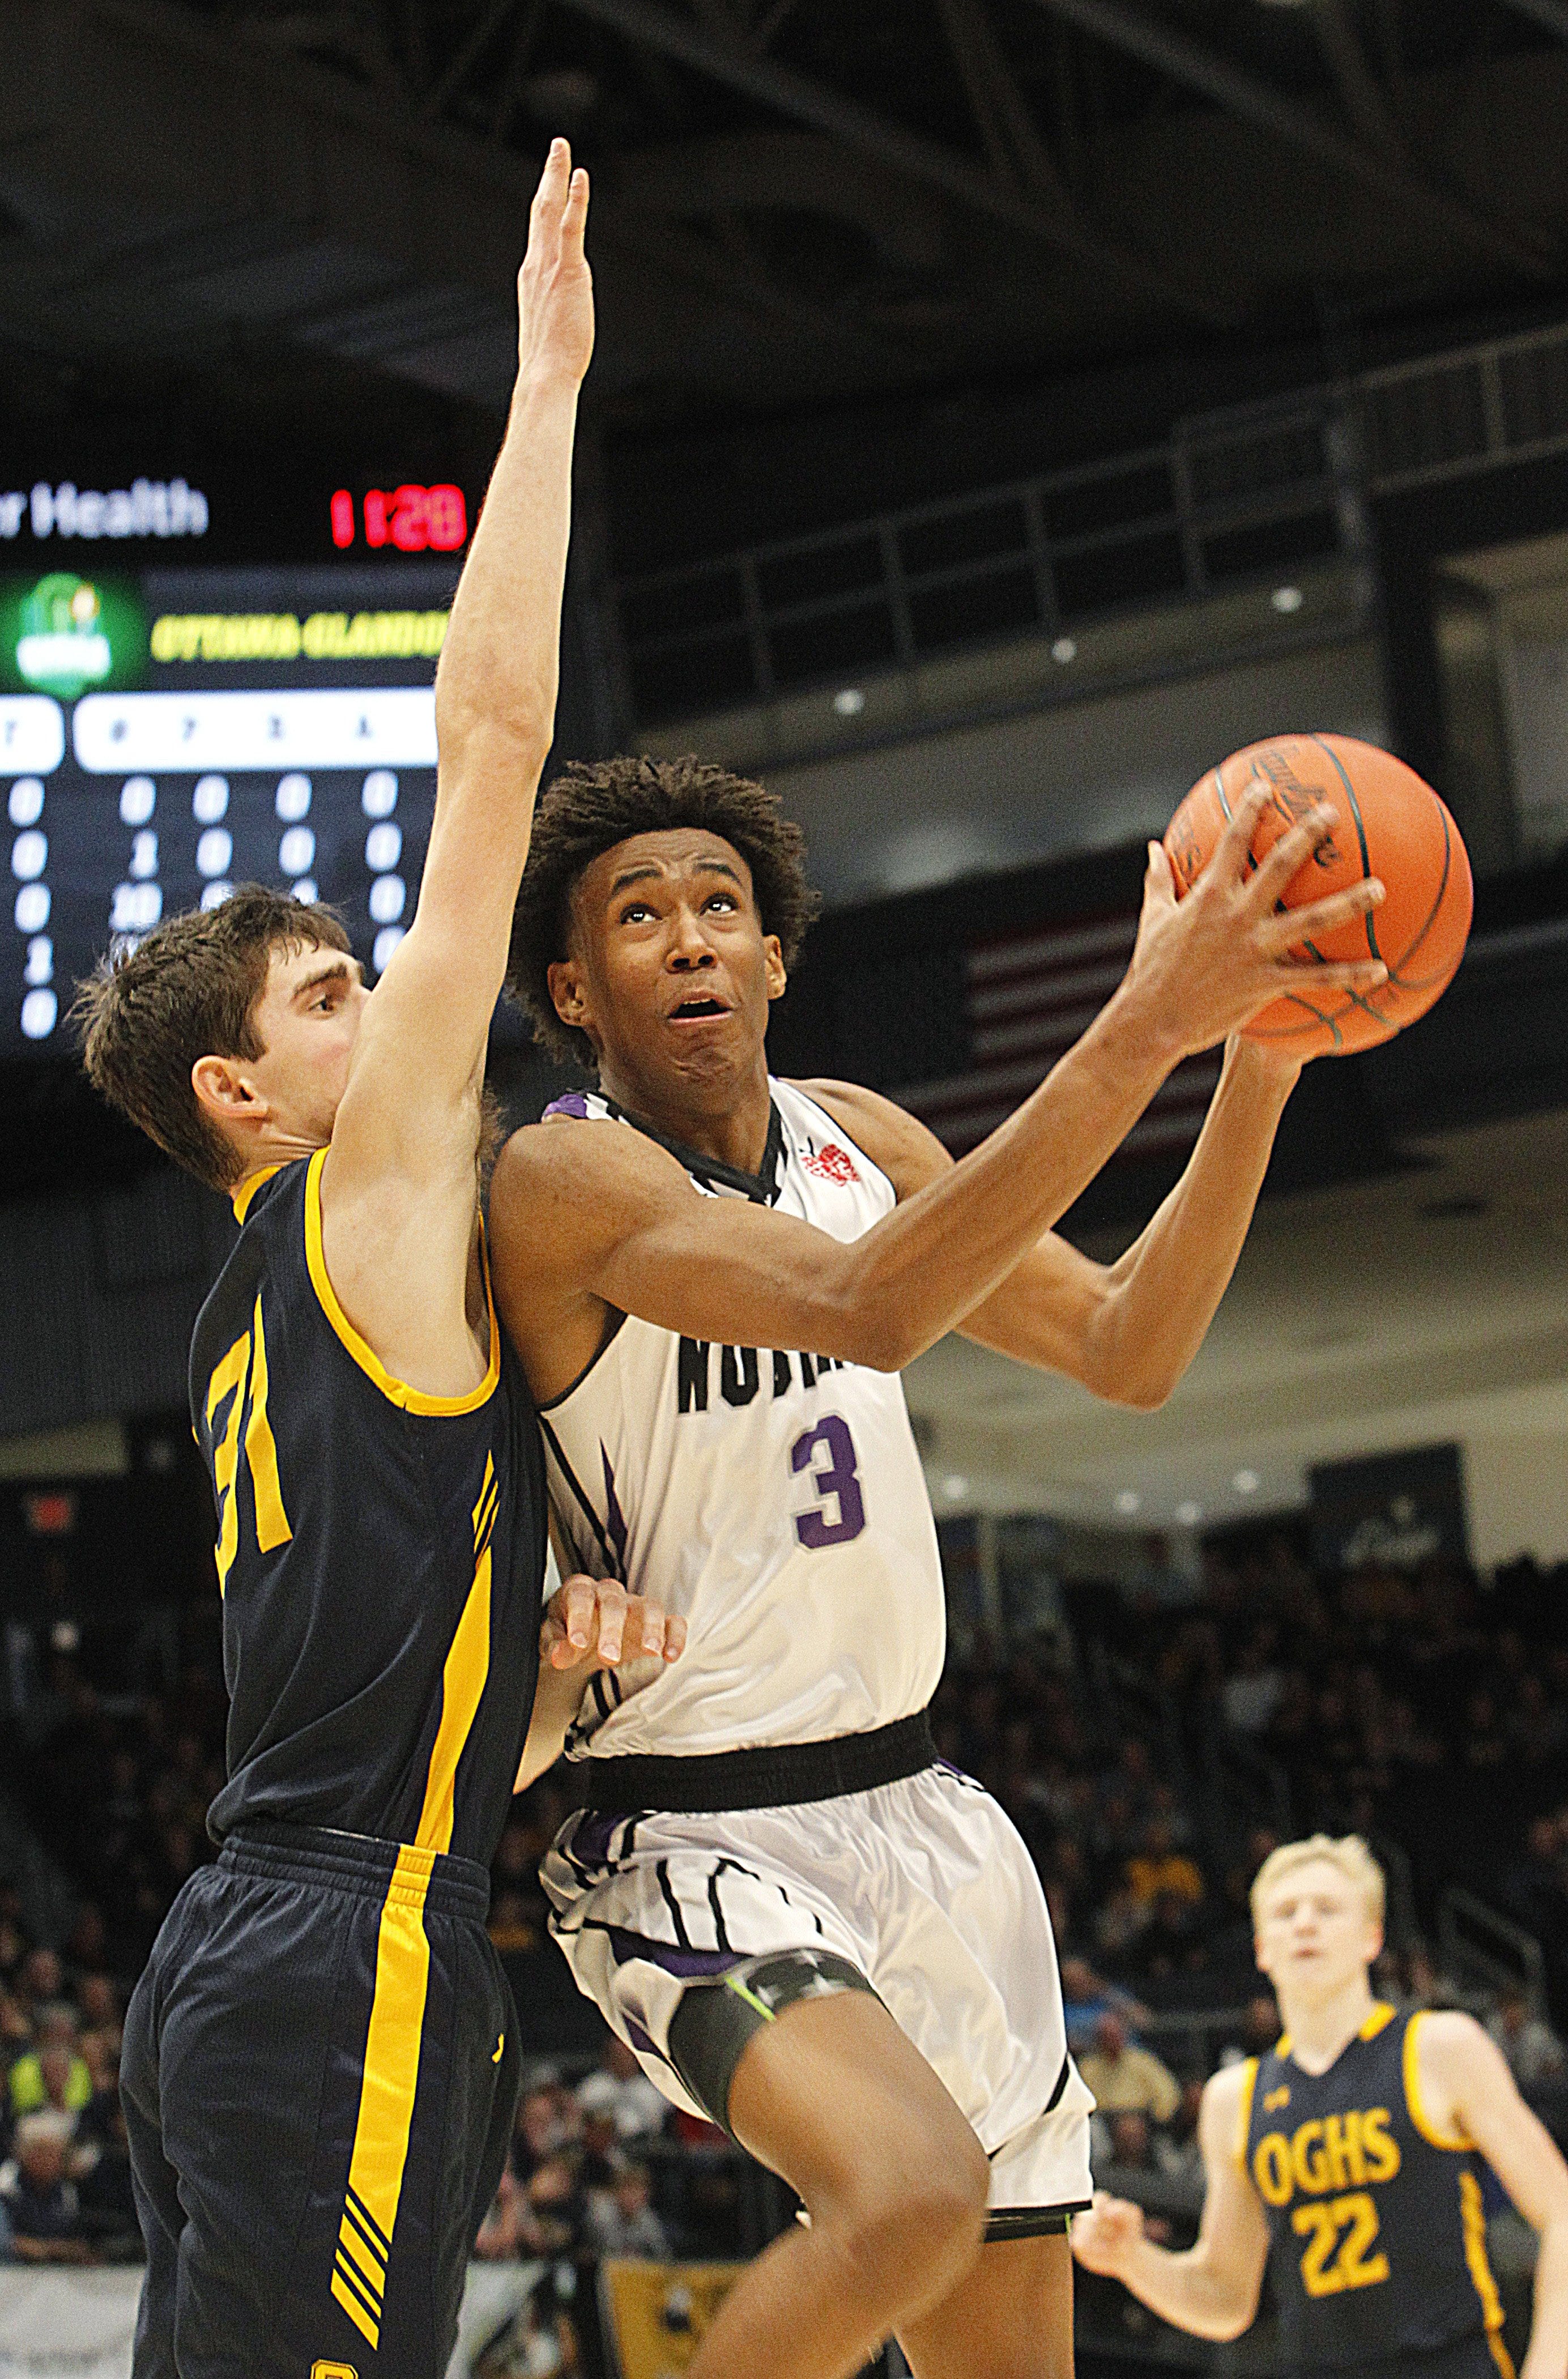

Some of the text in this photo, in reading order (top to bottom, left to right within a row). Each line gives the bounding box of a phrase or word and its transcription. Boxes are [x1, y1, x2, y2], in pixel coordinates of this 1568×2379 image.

[31, 480, 208, 538] Health
[791, 1414, 867, 1550] 3
[1253, 2107, 1401, 2206] OGHS
[1292, 2192, 1390, 2298] 22
